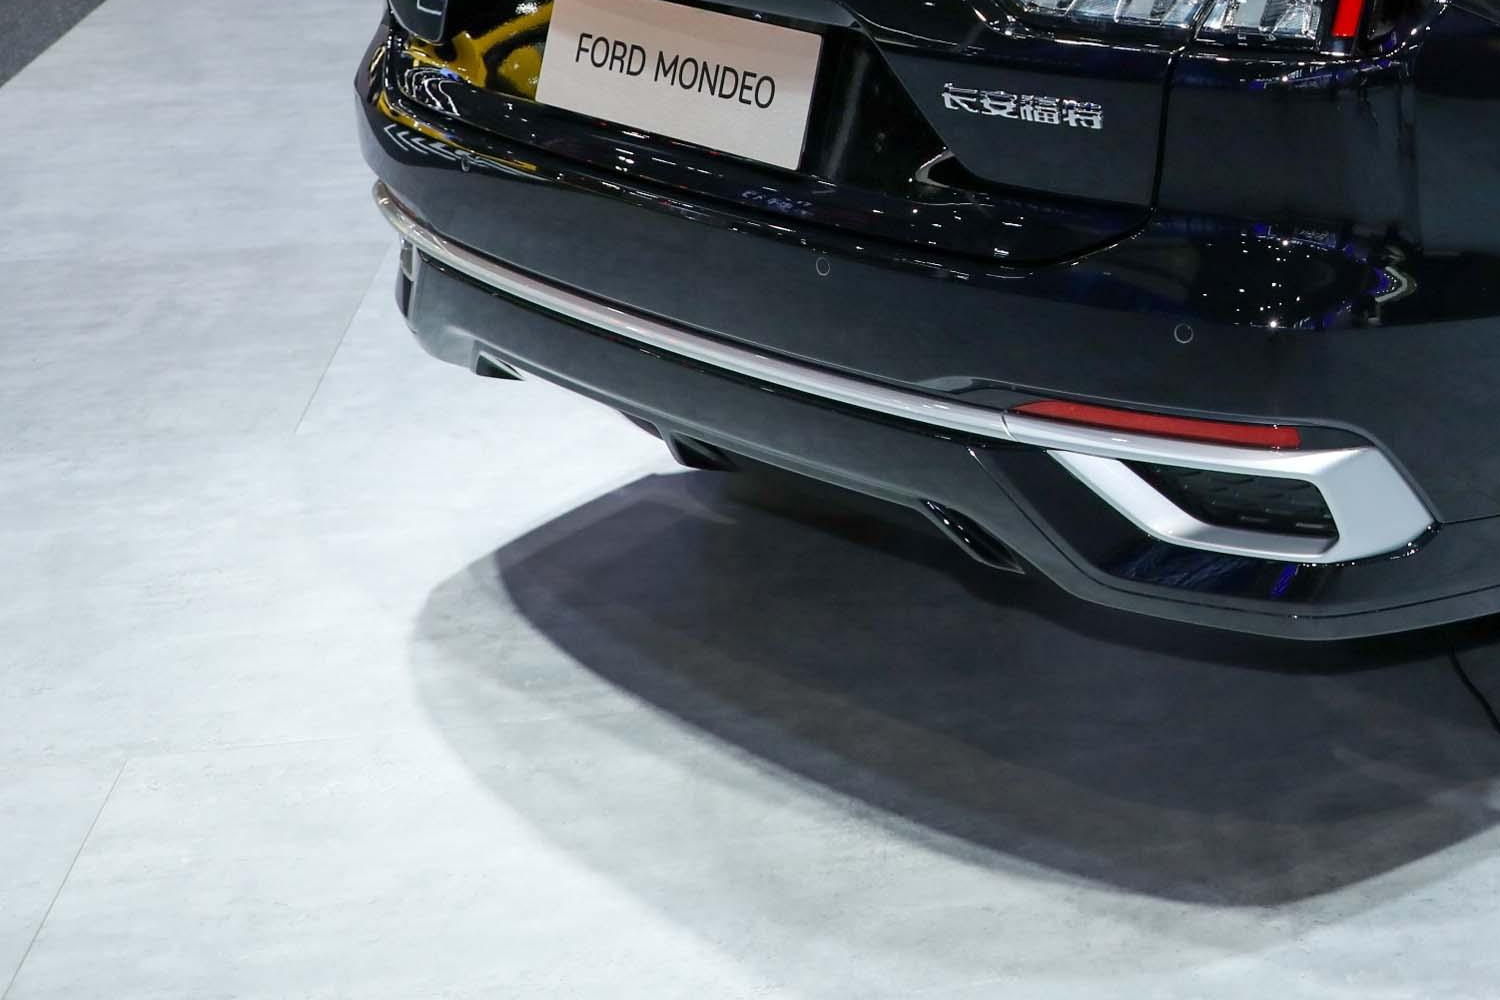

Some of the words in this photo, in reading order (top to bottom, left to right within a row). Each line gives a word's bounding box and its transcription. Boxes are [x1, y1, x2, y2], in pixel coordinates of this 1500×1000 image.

[575, 32, 646, 77] FORD
[653, 50, 776, 109] MONDEO
[941, 82, 1104, 130] 长安福特
